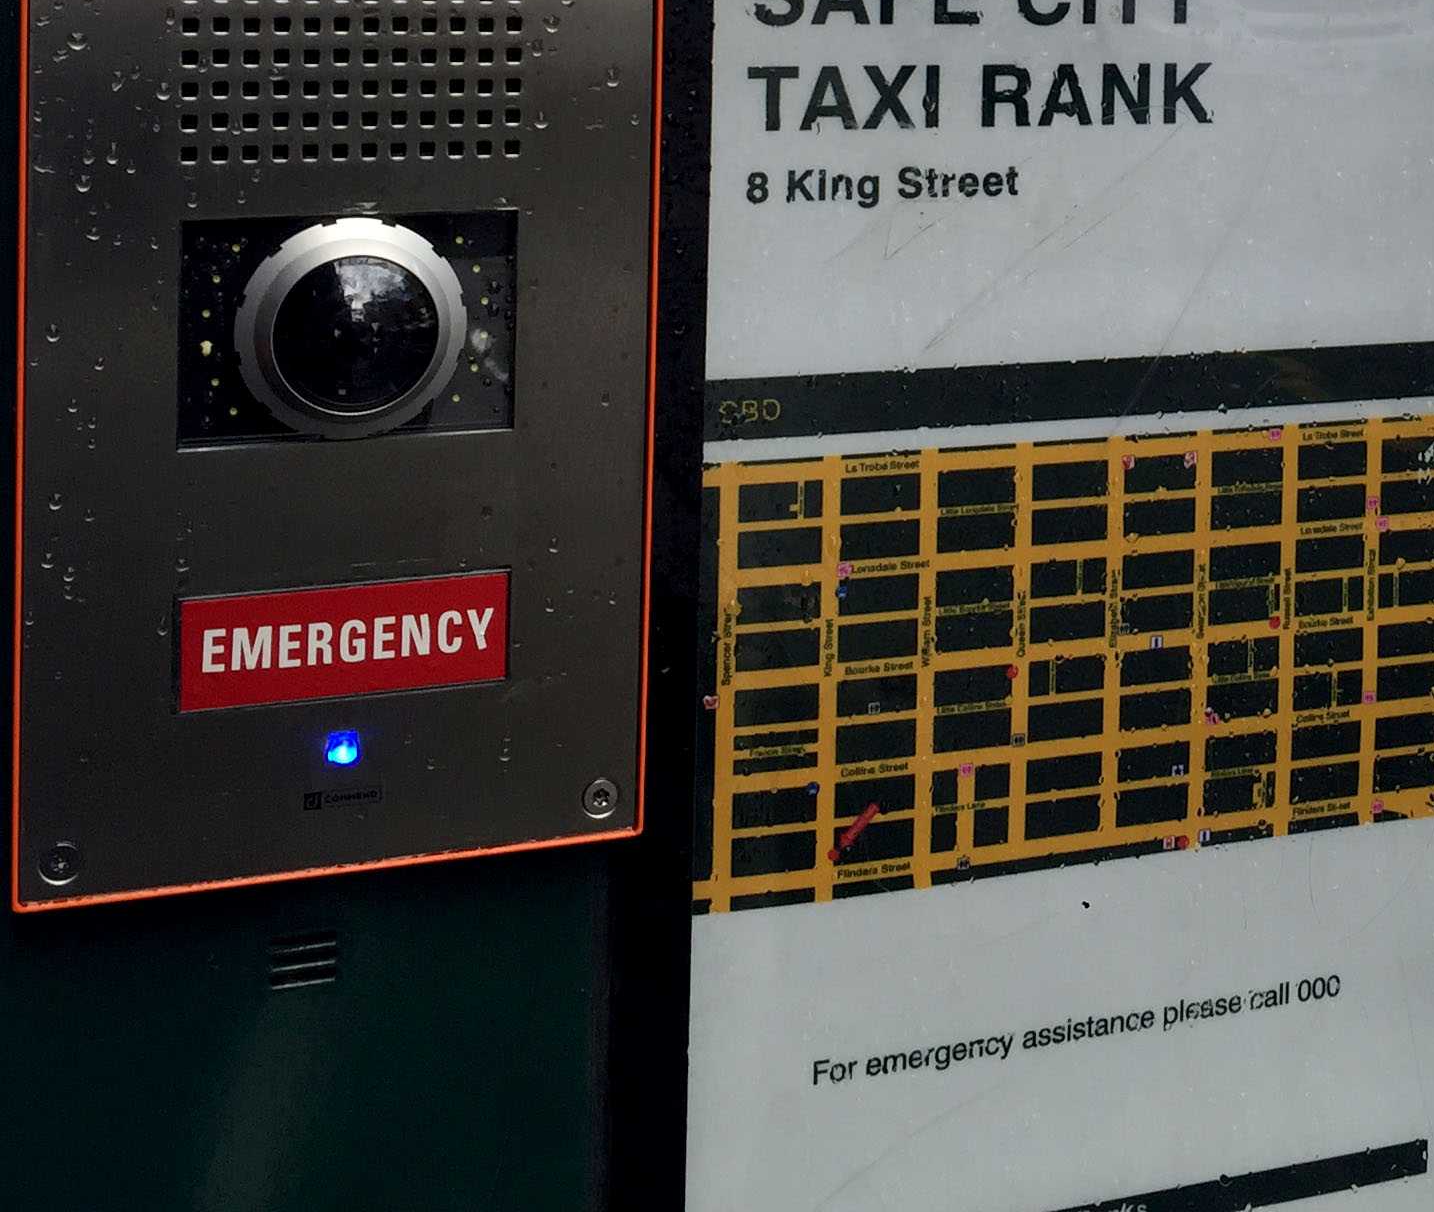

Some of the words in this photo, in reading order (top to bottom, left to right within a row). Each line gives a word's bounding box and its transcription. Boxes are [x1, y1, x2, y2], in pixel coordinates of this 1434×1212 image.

[748, 64, 940, 131] TAXI
[981, 62, 1214, 128] RANK
[746, 171, 769, 204] 8
[786, 169, 881, 208] King
[898, 165, 1019, 199] Street
[719, 398, 781, 424] CBD
[845, 464, 858, 474] La
[860, 461, 889, 473] Trobe
[890, 459, 920, 470] Street
[900, 559, 931, 570] Street
[201, 607, 494, 674] EMERGENCY
[824, 618, 834, 651] Street
[823, 653, 836, 678] King
[844, 664, 881, 676] Bourke
[883, 661, 914, 672] Street
[841, 766, 876, 778] Collins
[879, 762, 909, 774] Street
[837, 866, 878, 879] Flinders
[880, 862, 911, 874] Street
[811, 1057, 854, 1086] For
[865, 1032, 1014, 1078] emergency
[1021, 1005, 1155, 1051] assistance
[1162, 991, 1243, 1031] please
[1249, 981, 1291, 1012] call
[1297, 974, 1342, 1003] 000
